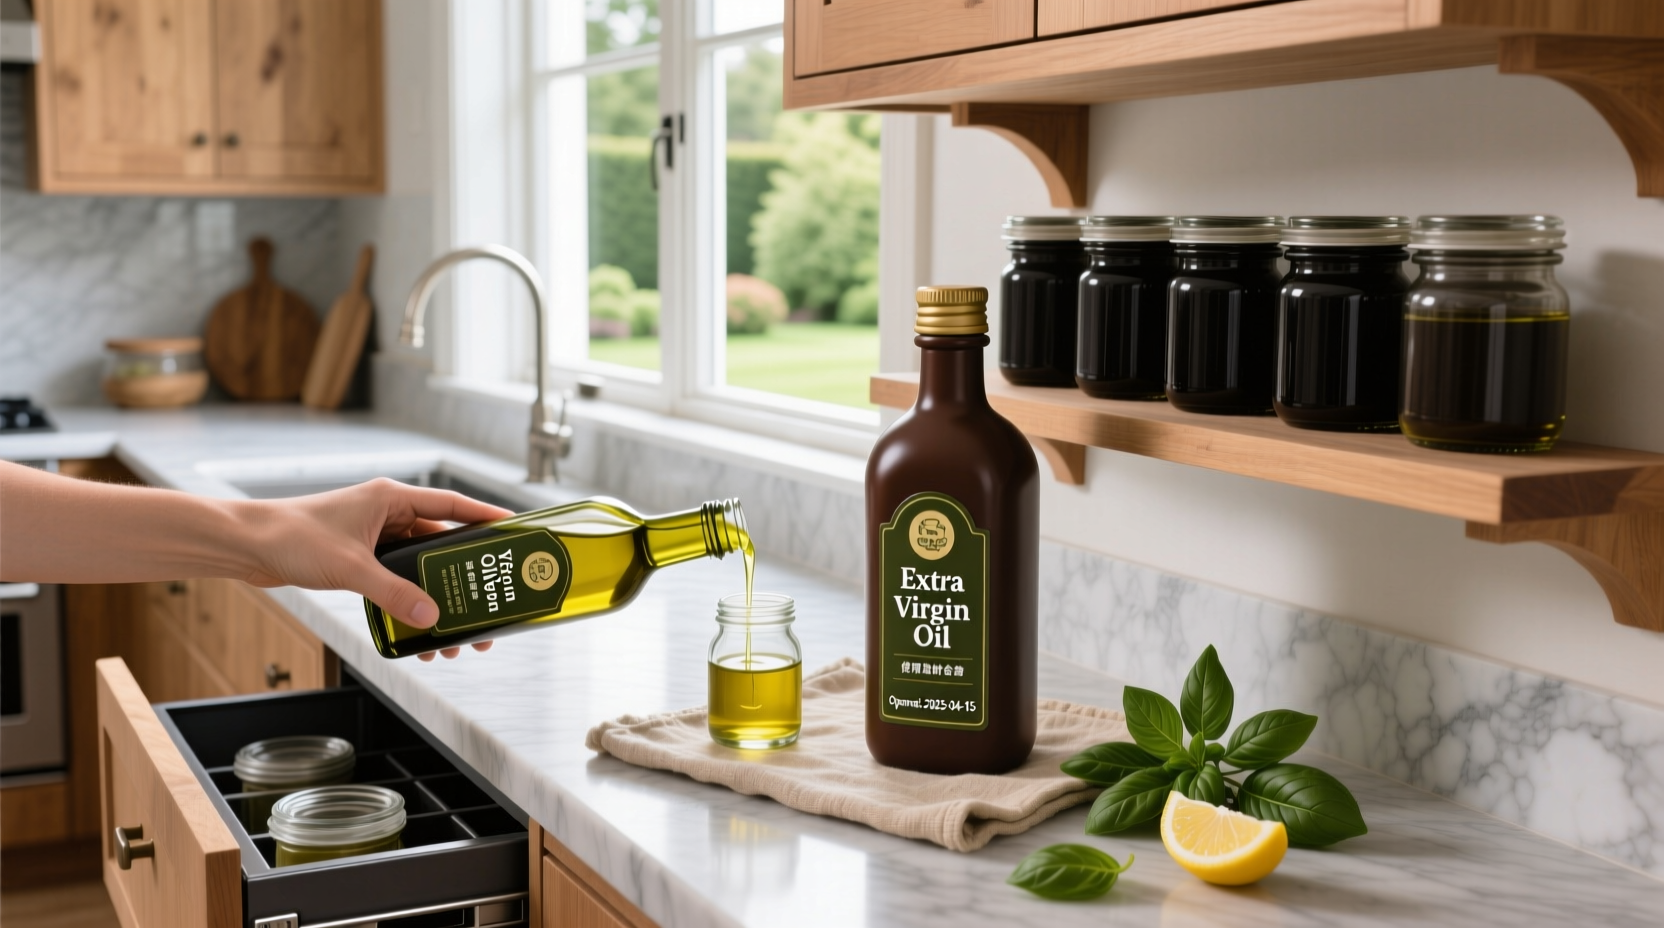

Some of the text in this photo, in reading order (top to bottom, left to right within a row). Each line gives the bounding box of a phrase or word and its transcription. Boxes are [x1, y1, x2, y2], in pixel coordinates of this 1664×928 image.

[900, 566, 965, 593] Extra
[893, 595, 971, 626] Virgin
[913, 623, 951, 649] Oil
